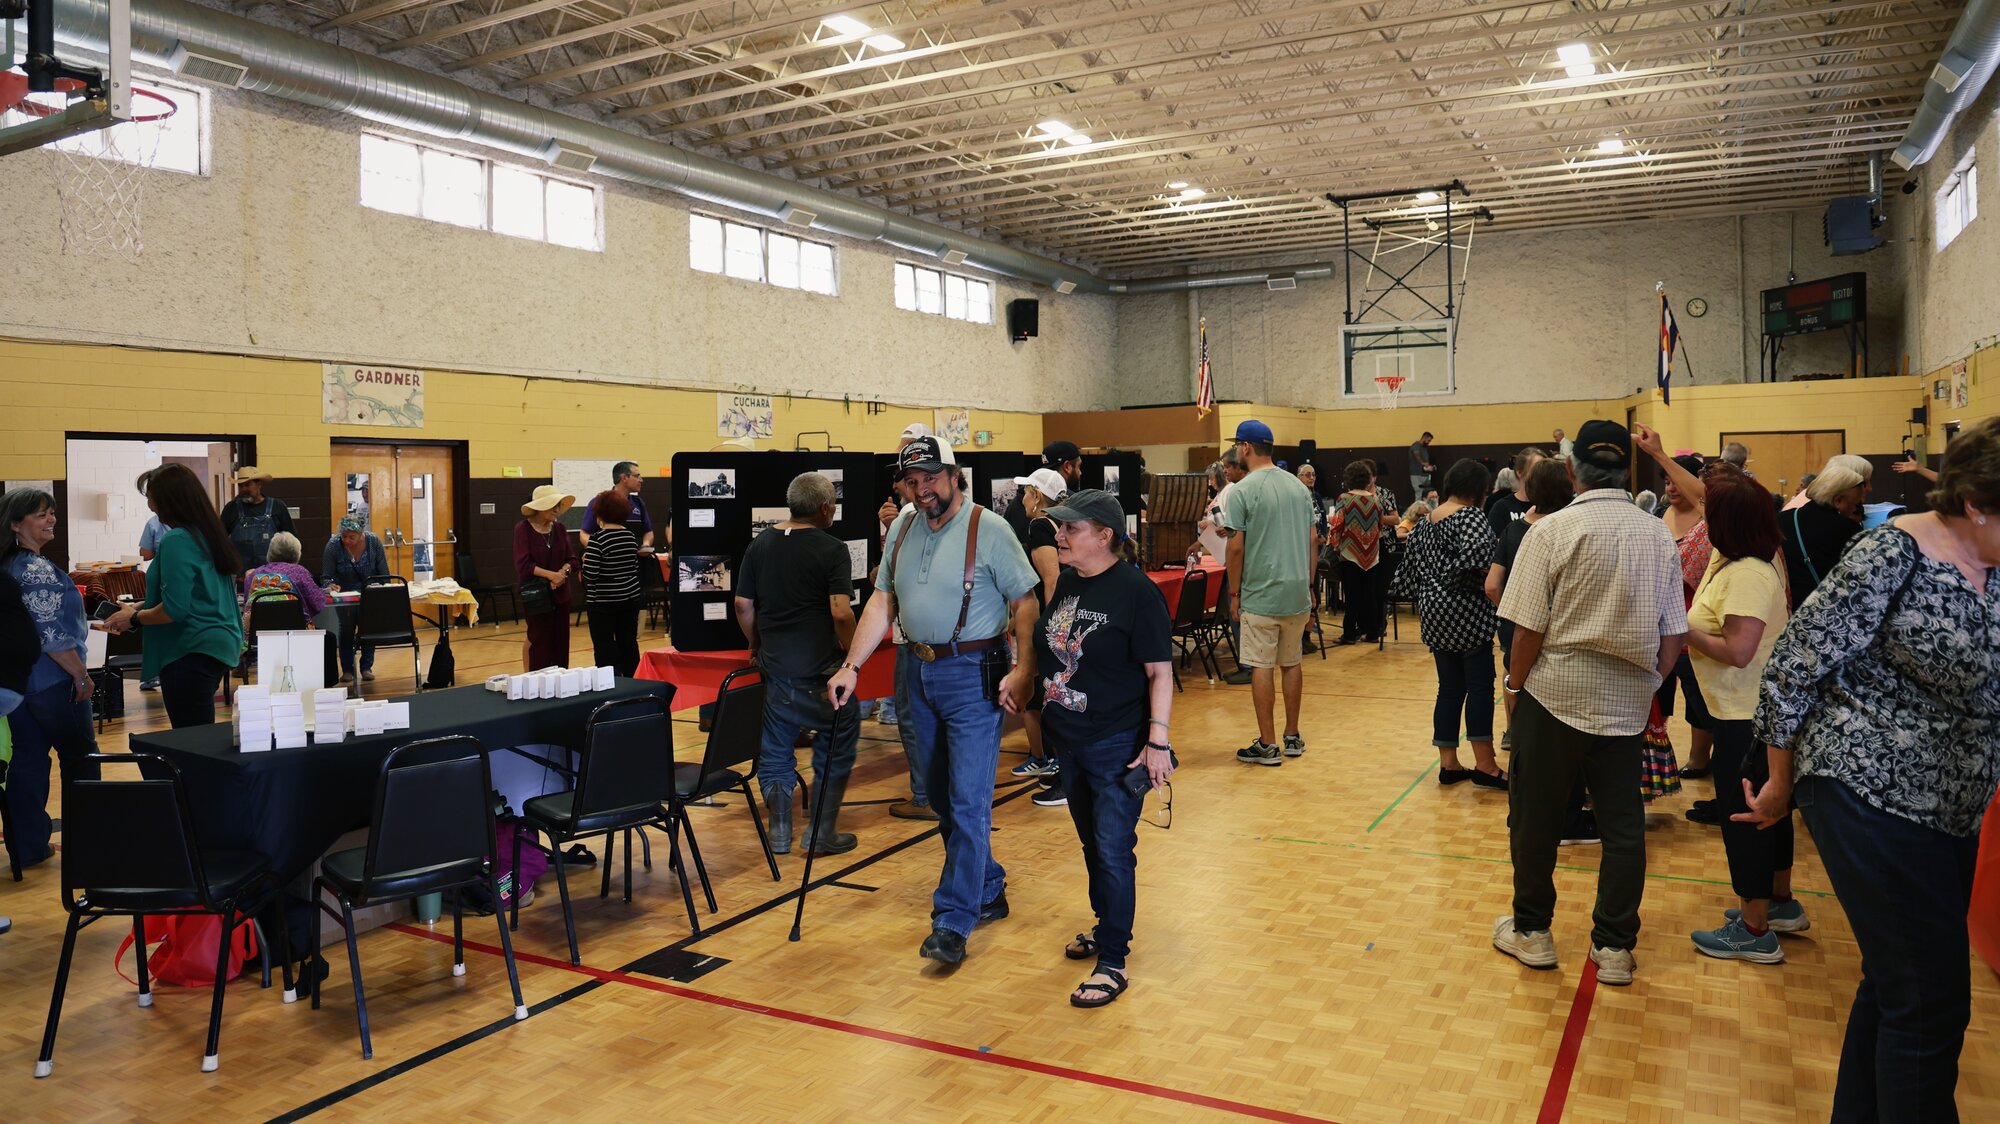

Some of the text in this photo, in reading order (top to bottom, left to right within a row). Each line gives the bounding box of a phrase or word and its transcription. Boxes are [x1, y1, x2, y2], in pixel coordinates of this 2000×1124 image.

[1800, 316, 1818, 326] BONUS
[354, 369, 420, 386] GARDNER
[733, 396, 770, 408] CUCHARA
[1075, 608, 1109, 624] SANTANA
